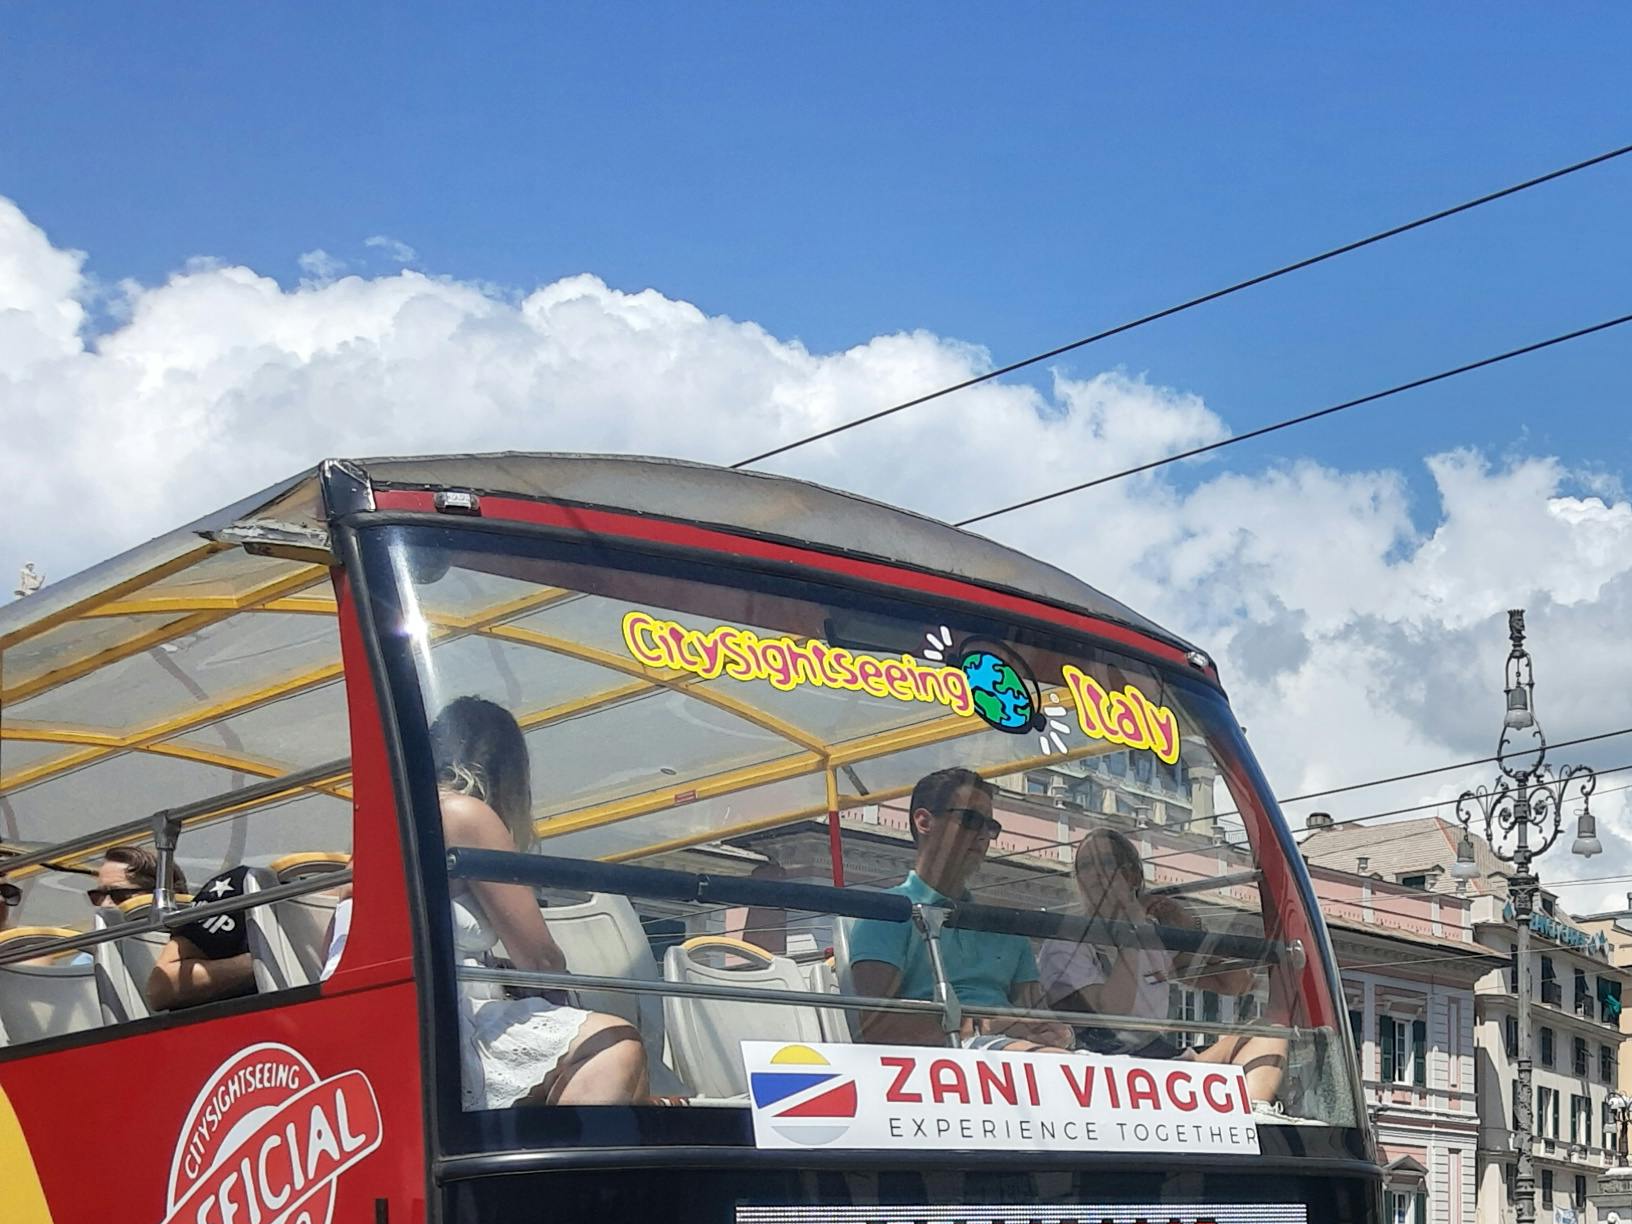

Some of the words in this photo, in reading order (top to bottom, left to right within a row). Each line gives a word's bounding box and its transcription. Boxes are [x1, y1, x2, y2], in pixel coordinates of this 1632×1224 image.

[1064, 666, 1181, 765] Italy
[184, 1062, 300, 1180] CITYSIGHTSEEING
[879, 1056, 1041, 1107] ZANI
[1061, 1064, 1252, 1115] VIAGGI
[890, 1117, 1099, 1141] EXPERIENCE
[1117, 1123, 1258, 1145] TOGETHER
